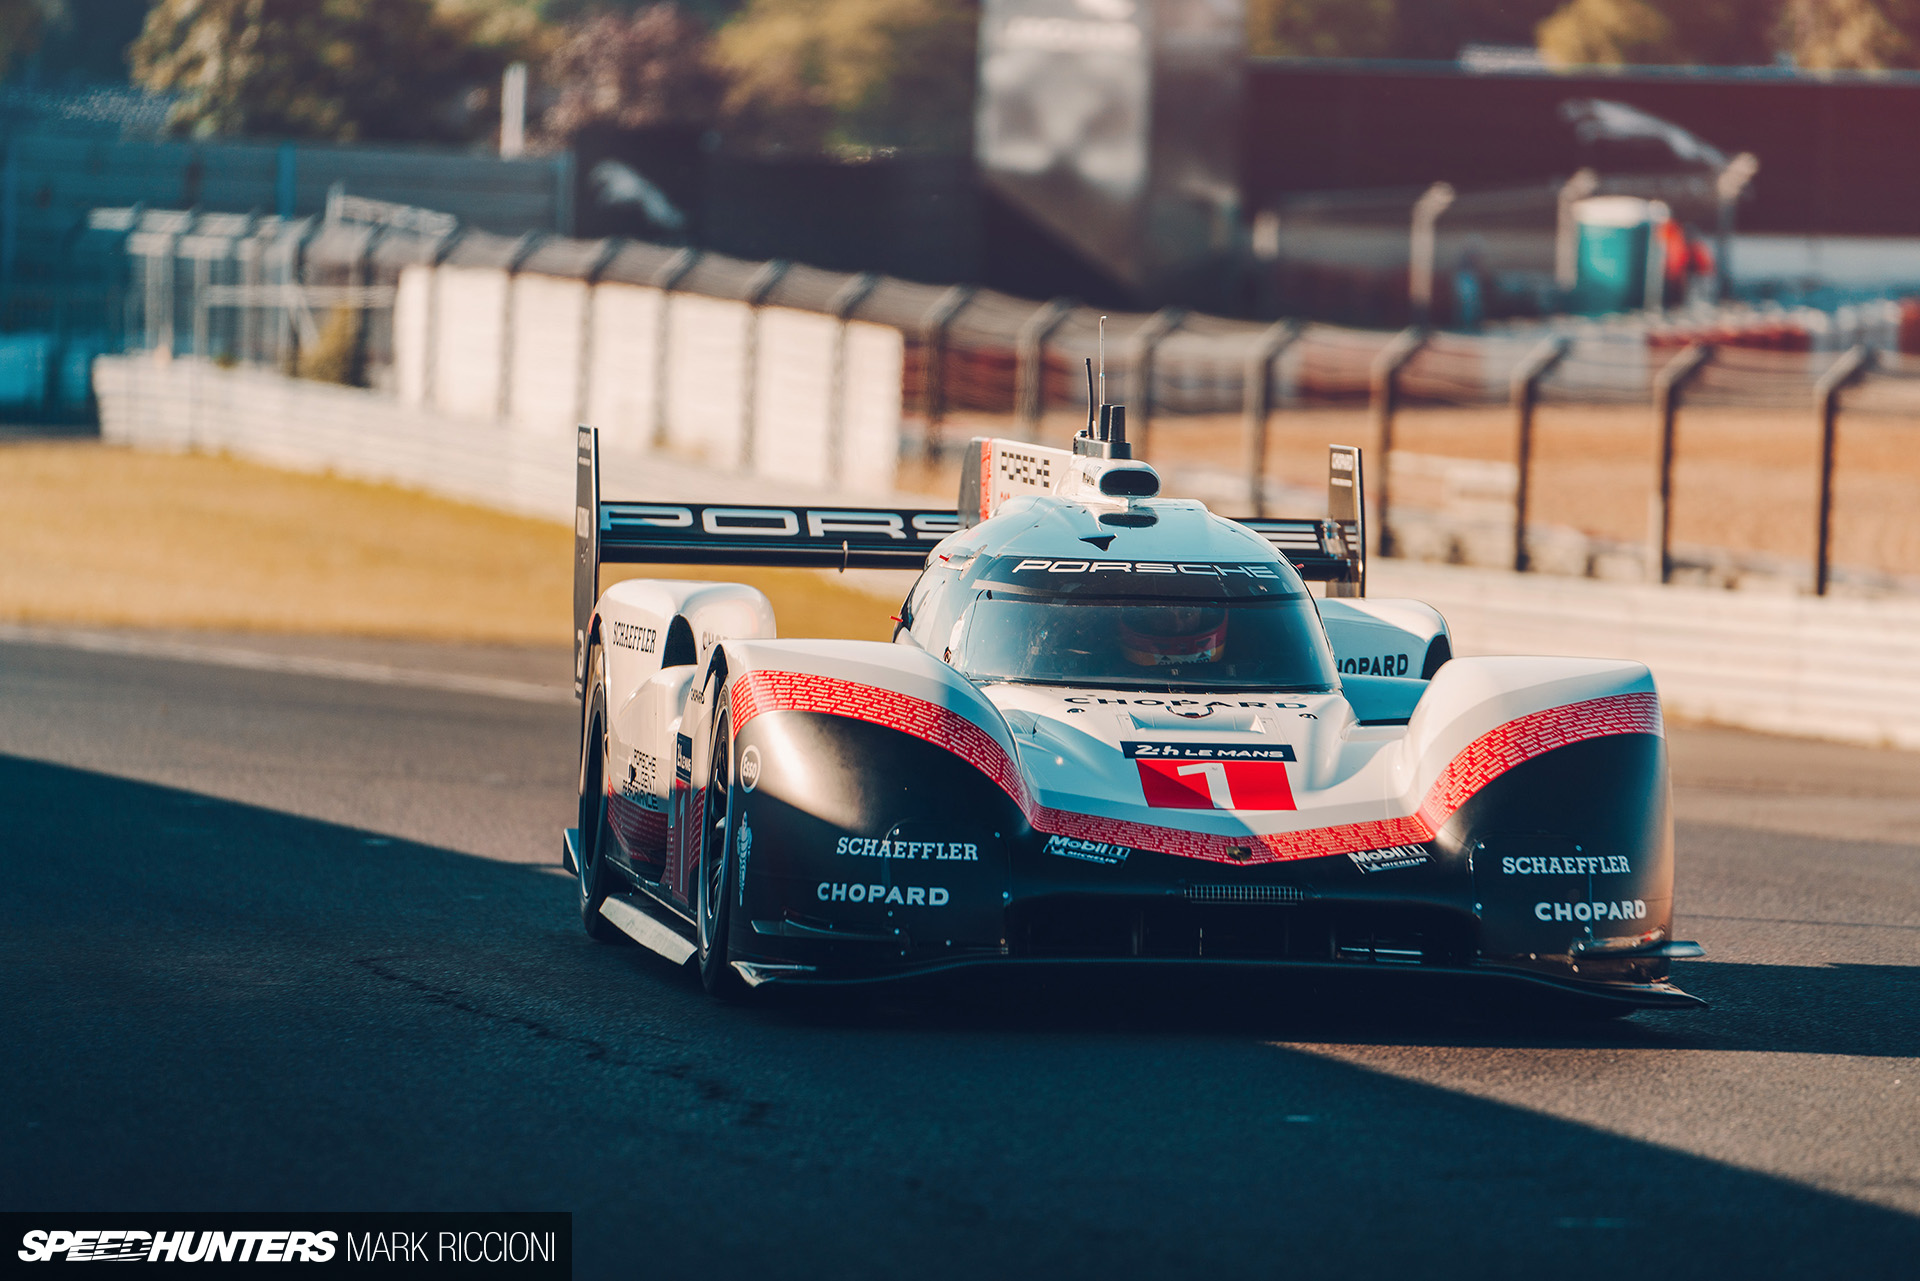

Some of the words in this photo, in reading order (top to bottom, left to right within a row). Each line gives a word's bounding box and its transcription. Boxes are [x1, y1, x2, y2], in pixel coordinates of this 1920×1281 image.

[1012, 559, 1280, 579] PORSCHE
[612, 621, 657, 654] SCHAEFFLER
[1338, 654, 1408, 677] OPARD
[1063, 697, 1307, 709] CHOPARD
[1185, 749, 1213, 757] LE
[1217, 749, 1284, 758] MANS
[1177, 762, 1235, 809] 1
[836, 837, 979, 861] SCHAEFFLER
[1048, 834, 1109, 854] Mobil
[1347, 846, 1407, 864] Mobil
[1381, 857, 1428, 869] MICHELIN
[1502, 855, 1632, 875] SCHAEFFLER
[816, 882, 950, 907] CHOPARD
[1534, 899, 1648, 922] CHOPARD
